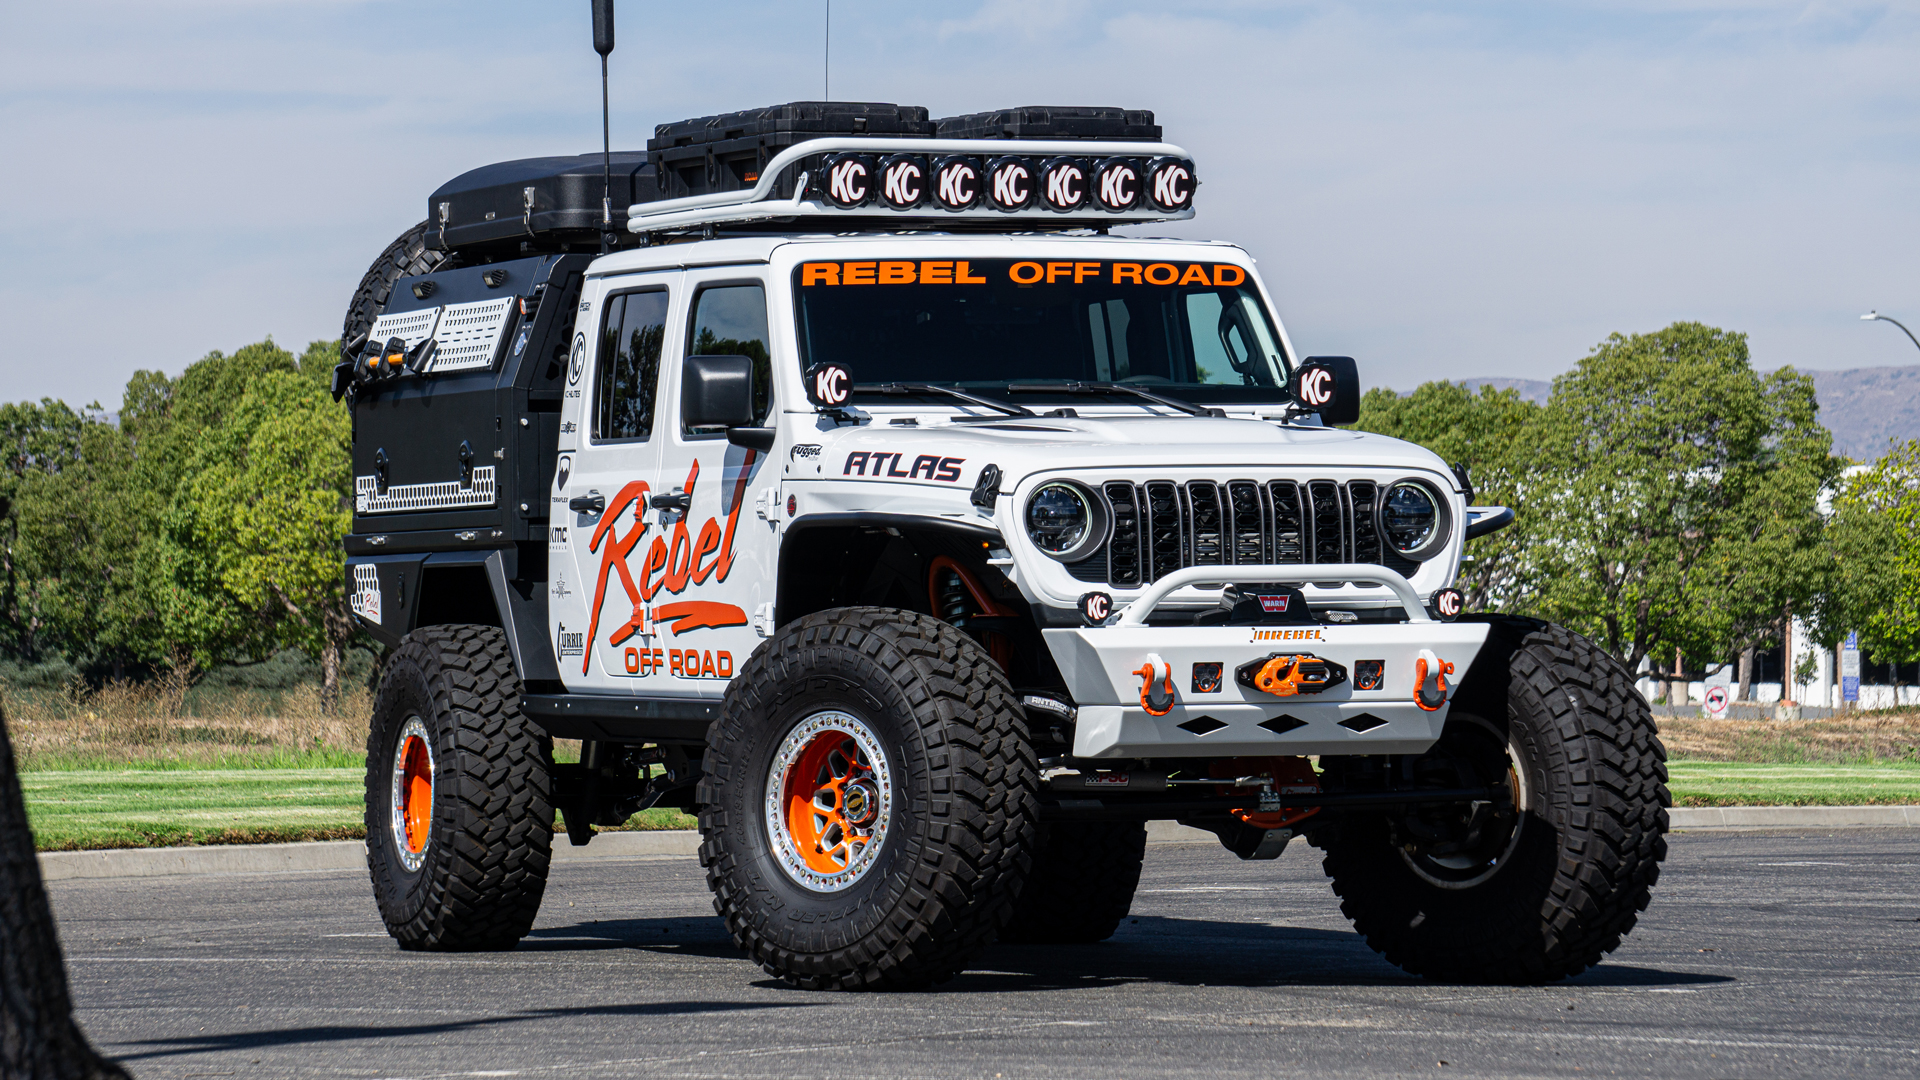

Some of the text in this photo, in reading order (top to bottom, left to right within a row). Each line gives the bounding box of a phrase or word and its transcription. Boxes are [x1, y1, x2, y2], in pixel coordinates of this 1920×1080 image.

[831, 160, 866, 203] KC
[885, 162, 921, 204] KC
[939, 163, 975, 206] KC
[994, 164, 1028, 206] KC
[1047, 165, 1082, 207] KC
[1101, 165, 1135, 207] KC
[1154, 165, 1189, 207] KC
[802, 261, 1246, 287] REBEL OFF ROAD
[816, 366, 848, 405] KC
[1300, 368, 1332, 406] KC
[843, 451, 967, 483] ATLAS
[582, 449, 756, 677] Rebel
[1087, 595, 1108, 620] KC
[1439, 591, 1460, 616] KC
[557, 621, 584, 664] CURRIE
[1270, 629, 1323, 641] REBEL
[625, 647, 734, 678] OFF ROAD
[1098, 771, 1128, 782] PSC
